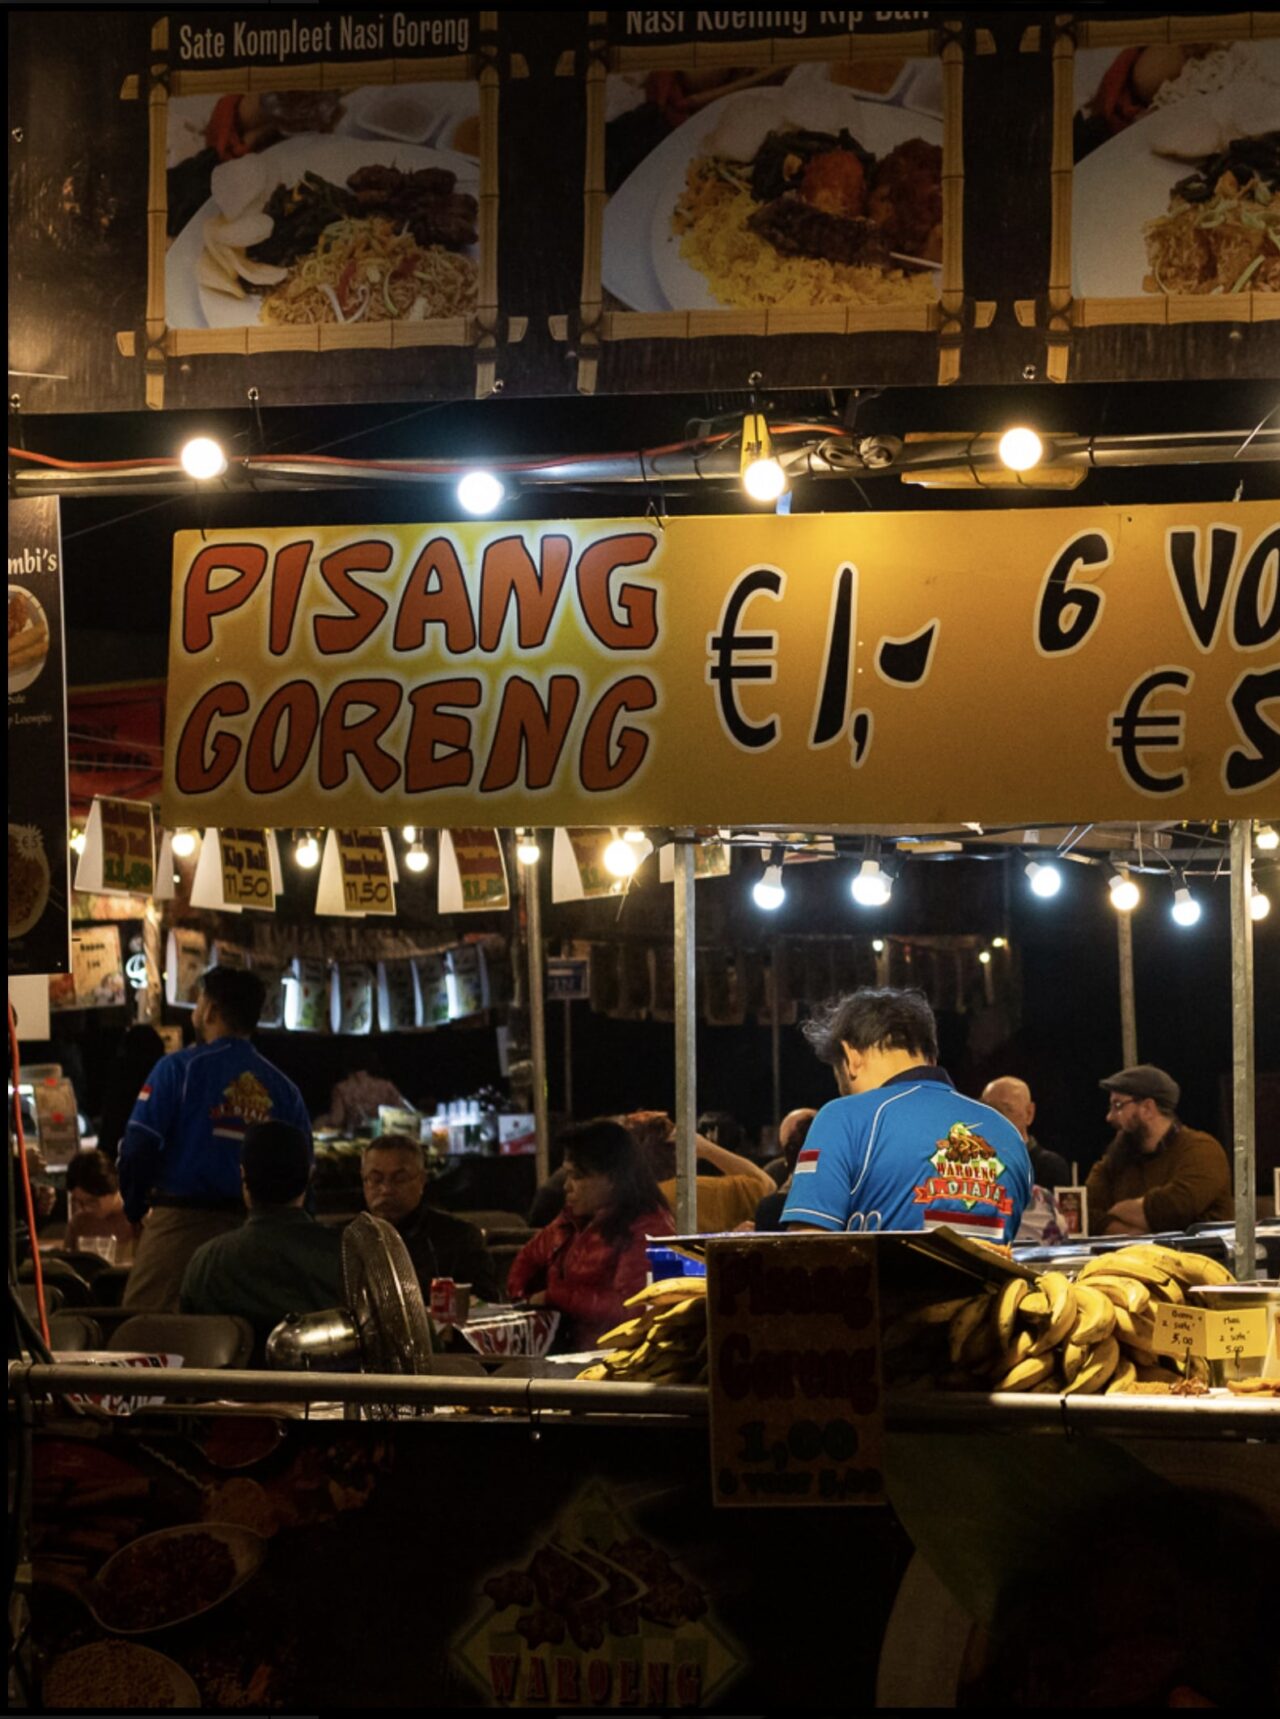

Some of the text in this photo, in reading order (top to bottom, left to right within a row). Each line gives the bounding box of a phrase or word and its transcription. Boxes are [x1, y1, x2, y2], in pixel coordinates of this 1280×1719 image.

[180, 12, 470, 62] Sate Kompleet Nasi Goreng
[626, 11, 684, 34] Nasi
[182, 533, 659, 656] PISANG
[1034, 527, 1113, 657] 6
[175, 675, 658, 794] GORENG
[936, 1162, 997, 1182] WAROENG
[717, 1252, 874, 1330] Pisang
[719, 1332, 879, 1415] Goreng
[738, 1418, 858, 1472] 1,00
[489, 1652, 704, 1707] WAROENG
